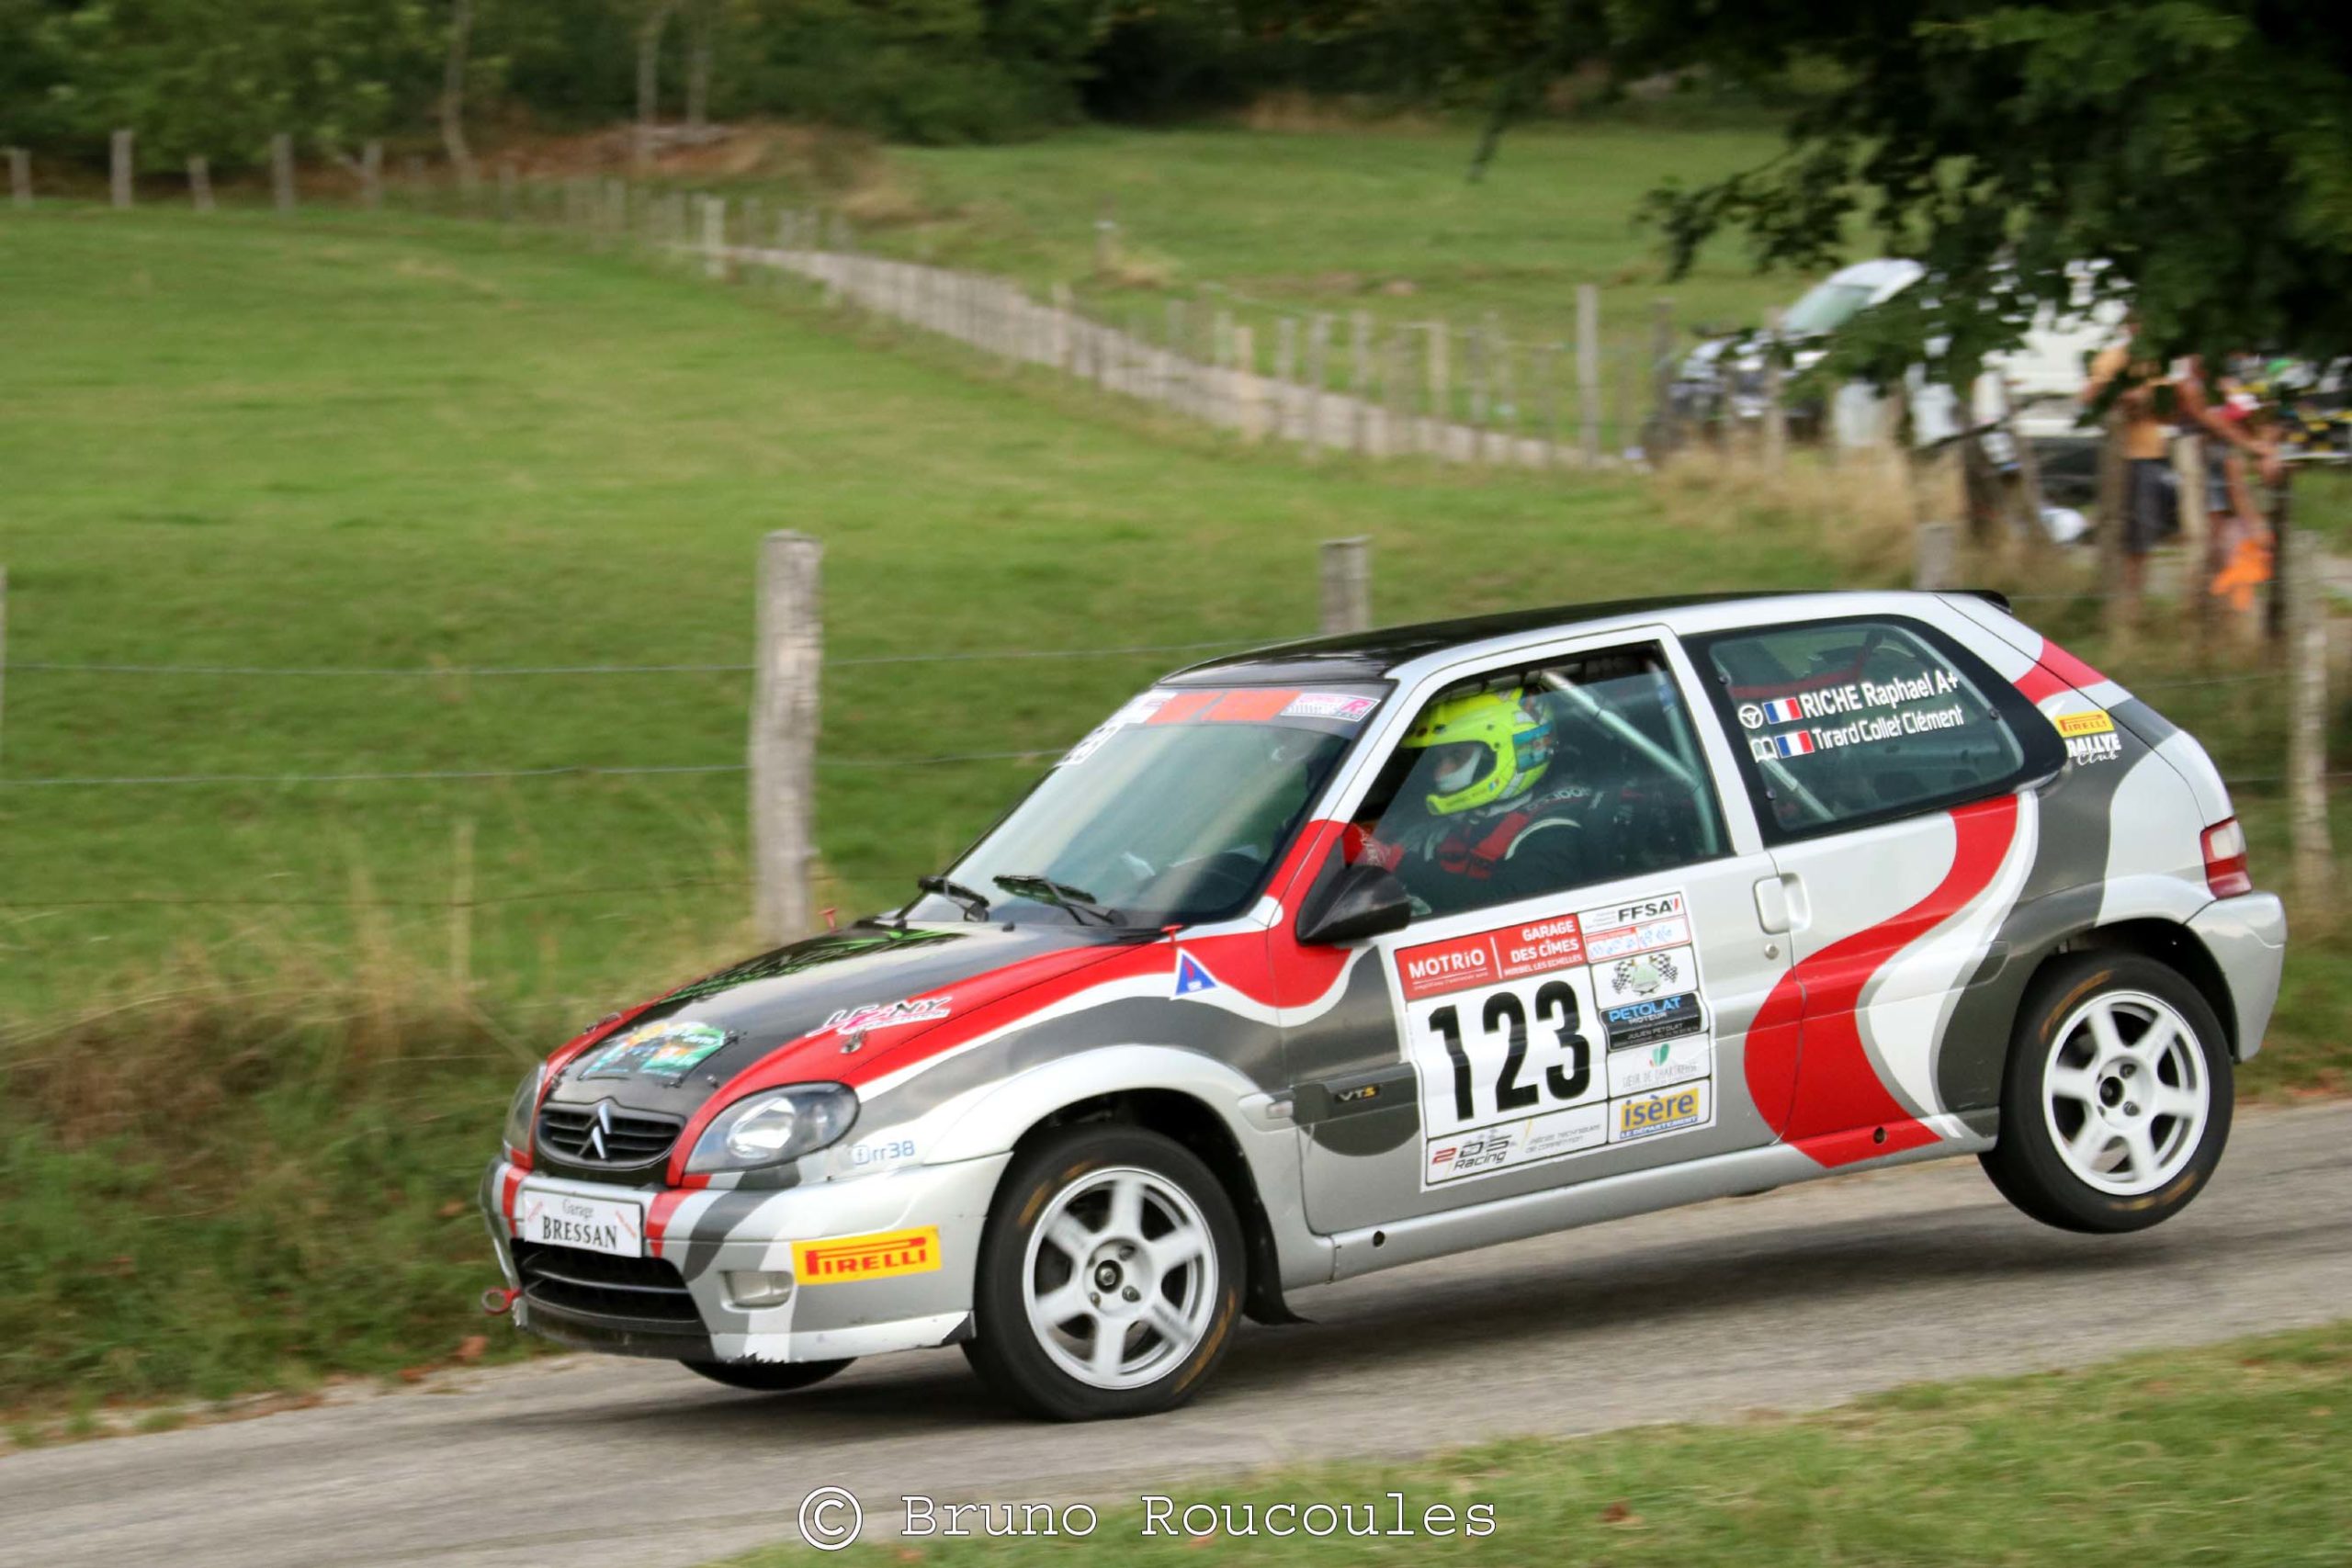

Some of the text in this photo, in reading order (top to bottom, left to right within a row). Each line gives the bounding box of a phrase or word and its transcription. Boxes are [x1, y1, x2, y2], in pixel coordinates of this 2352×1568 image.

[1799, 670, 1958, 718] RICHE Raphael A+
[1812, 705, 1964, 750] Tirard Collet Clément
[2059, 715, 2108, 732] PIRELLI
[2065, 732, 2121, 759] RALLYE
[2077, 749, 2119, 766] Club
[1618, 900, 1672, 922] FFSA
[1521, 919, 1576, 942] GARAGE
[1510, 945, 1541, 964] DES
[1539, 938, 1579, 957] CÎMES
[1609, 996, 1681, 1022] PETOLAT
[1628, 1012, 1668, 1024] MOTEUR
[1429, 981, 1591, 1122] 123
[1339, 1086, 1376, 1100] VTS
[1624, 1094, 1694, 1127] isère
[1453, 1150, 1508, 1171] Racing
[562, 1198, 594, 1219] Garage
[543, 1215, 616, 1249] BRESSAN
[806, 1236, 927, 1276] PIRELLI
